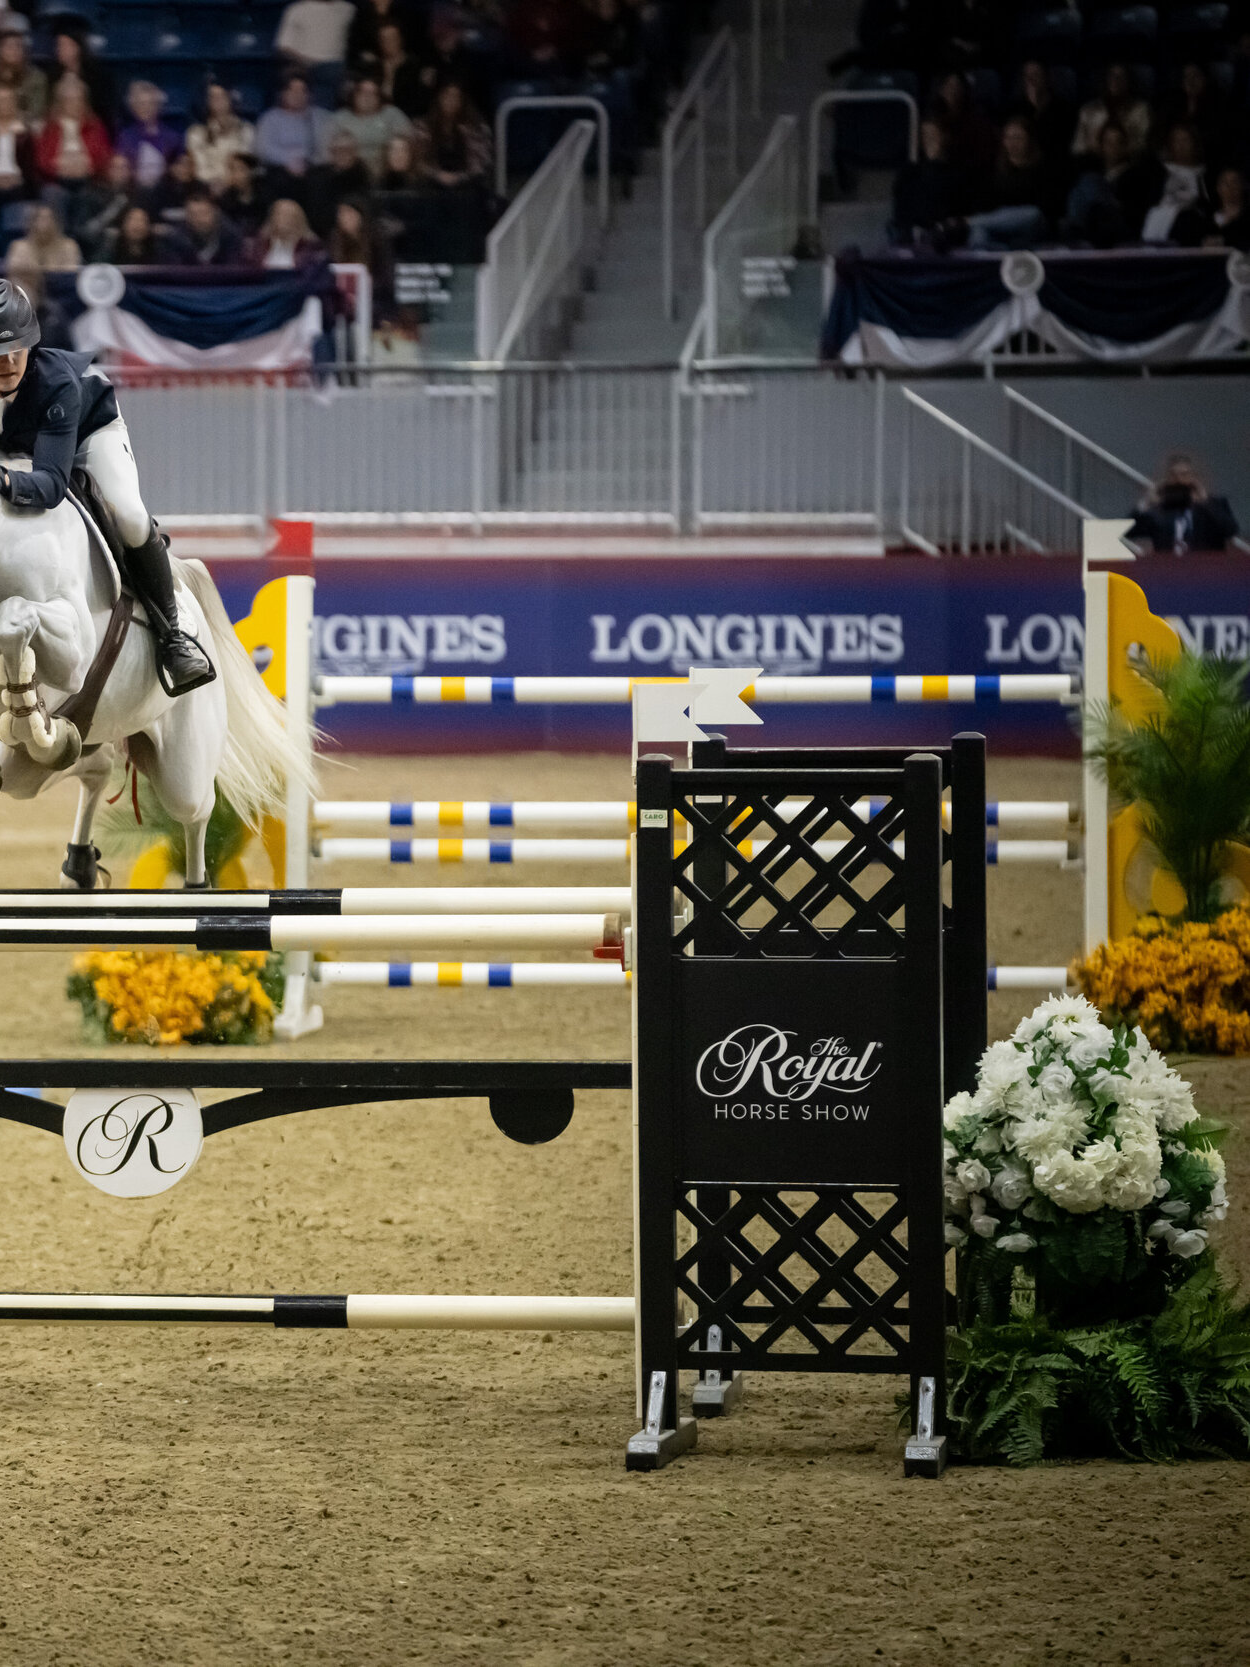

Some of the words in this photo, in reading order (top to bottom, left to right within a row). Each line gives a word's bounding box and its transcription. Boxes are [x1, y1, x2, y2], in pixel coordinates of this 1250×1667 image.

[591, 613, 905, 663] LONGINES
[696, 1023, 882, 1101] Royal
[810, 1036, 851, 1056] The
[76, 1093, 187, 1176] R
[714, 1103, 790, 1120] HORSE
[801, 1104, 870, 1121] SHOW
